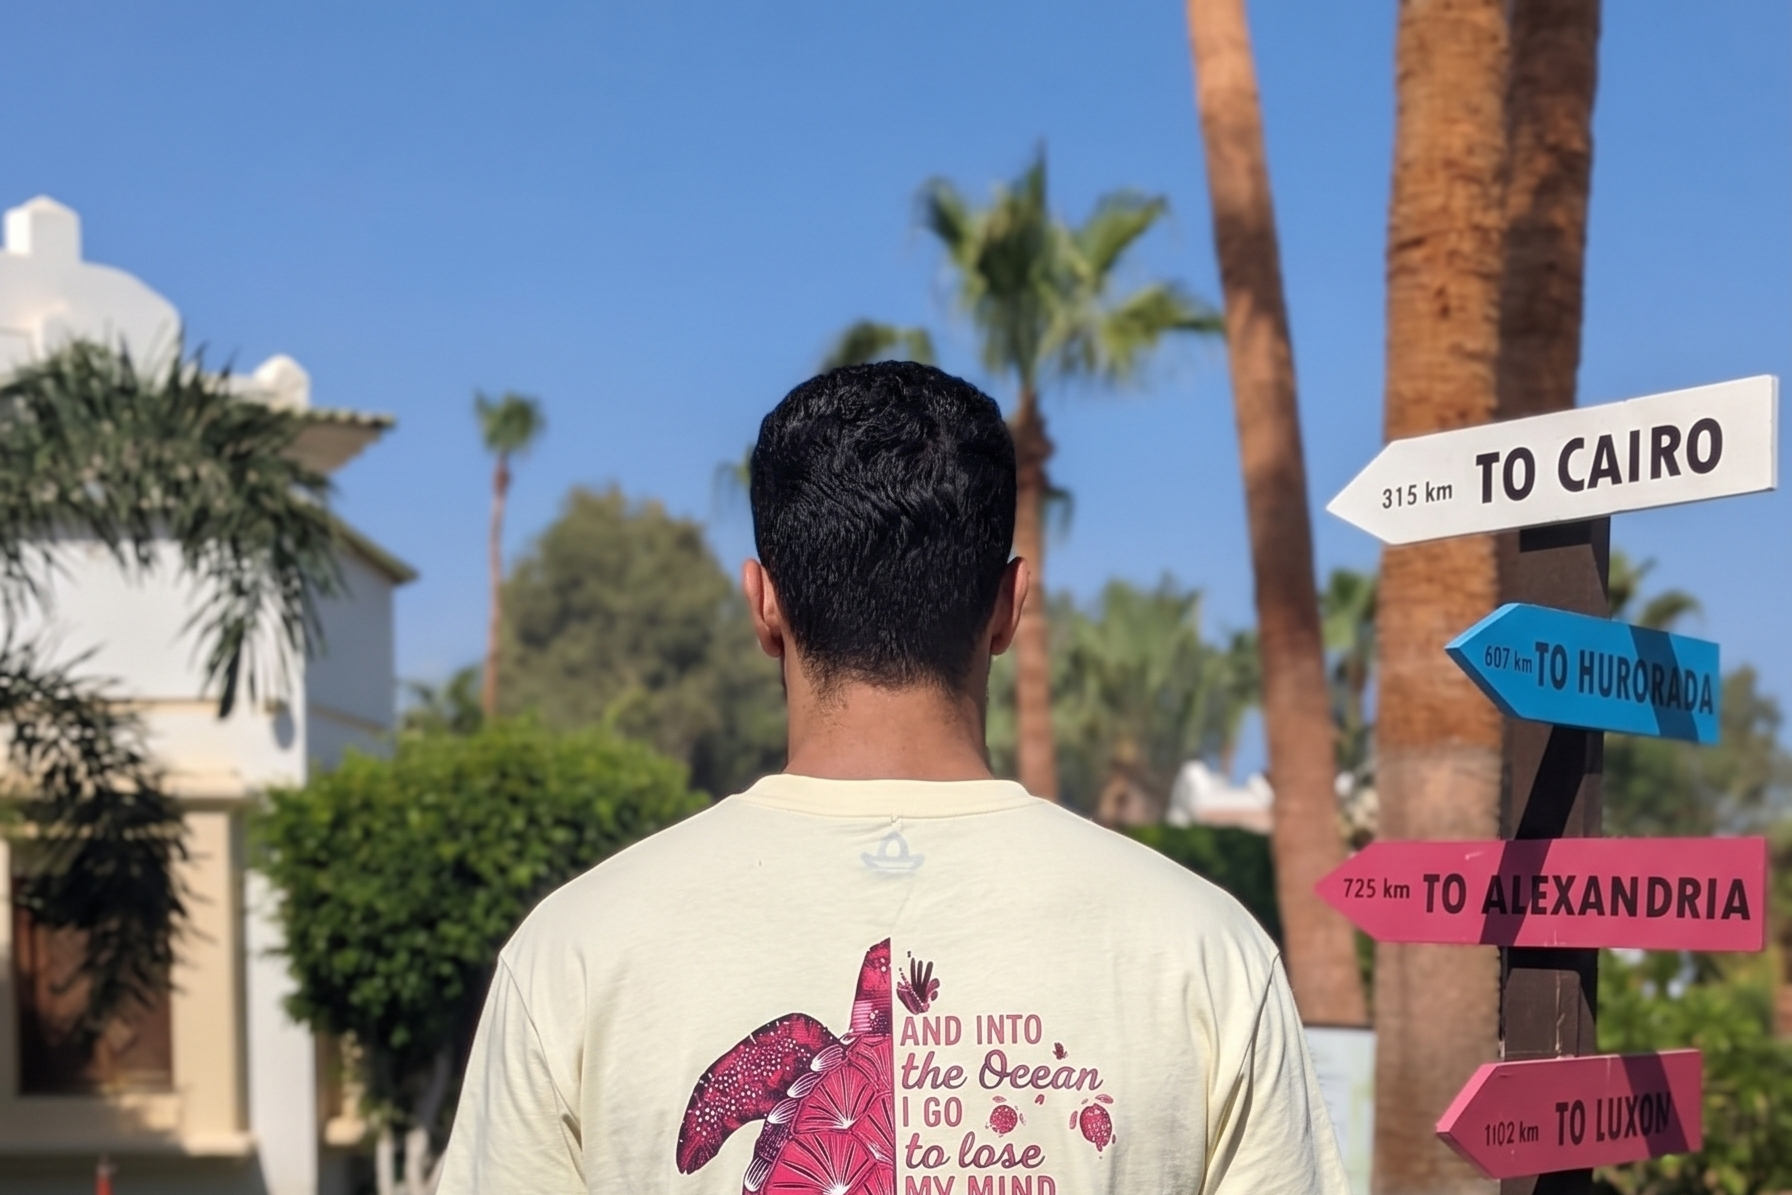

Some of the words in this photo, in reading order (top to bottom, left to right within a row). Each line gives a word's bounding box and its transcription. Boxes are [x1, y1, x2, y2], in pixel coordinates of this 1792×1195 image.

[1382, 484, 1417, 510] 315
[1425, 481, 1453, 503] km
[1475, 446, 1536, 504] TO
[1557, 417, 1723, 493] CAIRO
[1484, 645, 1511, 670] 607
[1514, 650, 1533, 674] km
[1534, 641, 1568, 691] TO
[1343, 878, 1377, 899] 725
[1383, 877, 1410, 899] km
[1422, 872, 1467, 915] TO
[1481, 873, 1751, 921] ALEXANDRIA
[900, 1013, 962, 1047] AND
[976, 1013, 1043, 1046] INTO
[901, 1050, 968, 1090] the
[902, 1096, 910, 1128] I
[923, 1096, 963, 1128] GO
[1519, 1120, 1539, 1143] km
[1555, 1099, 1586, 1147] TO
[904, 1132, 950, 1170] to
[958, 1131, 1046, 1170] lose
